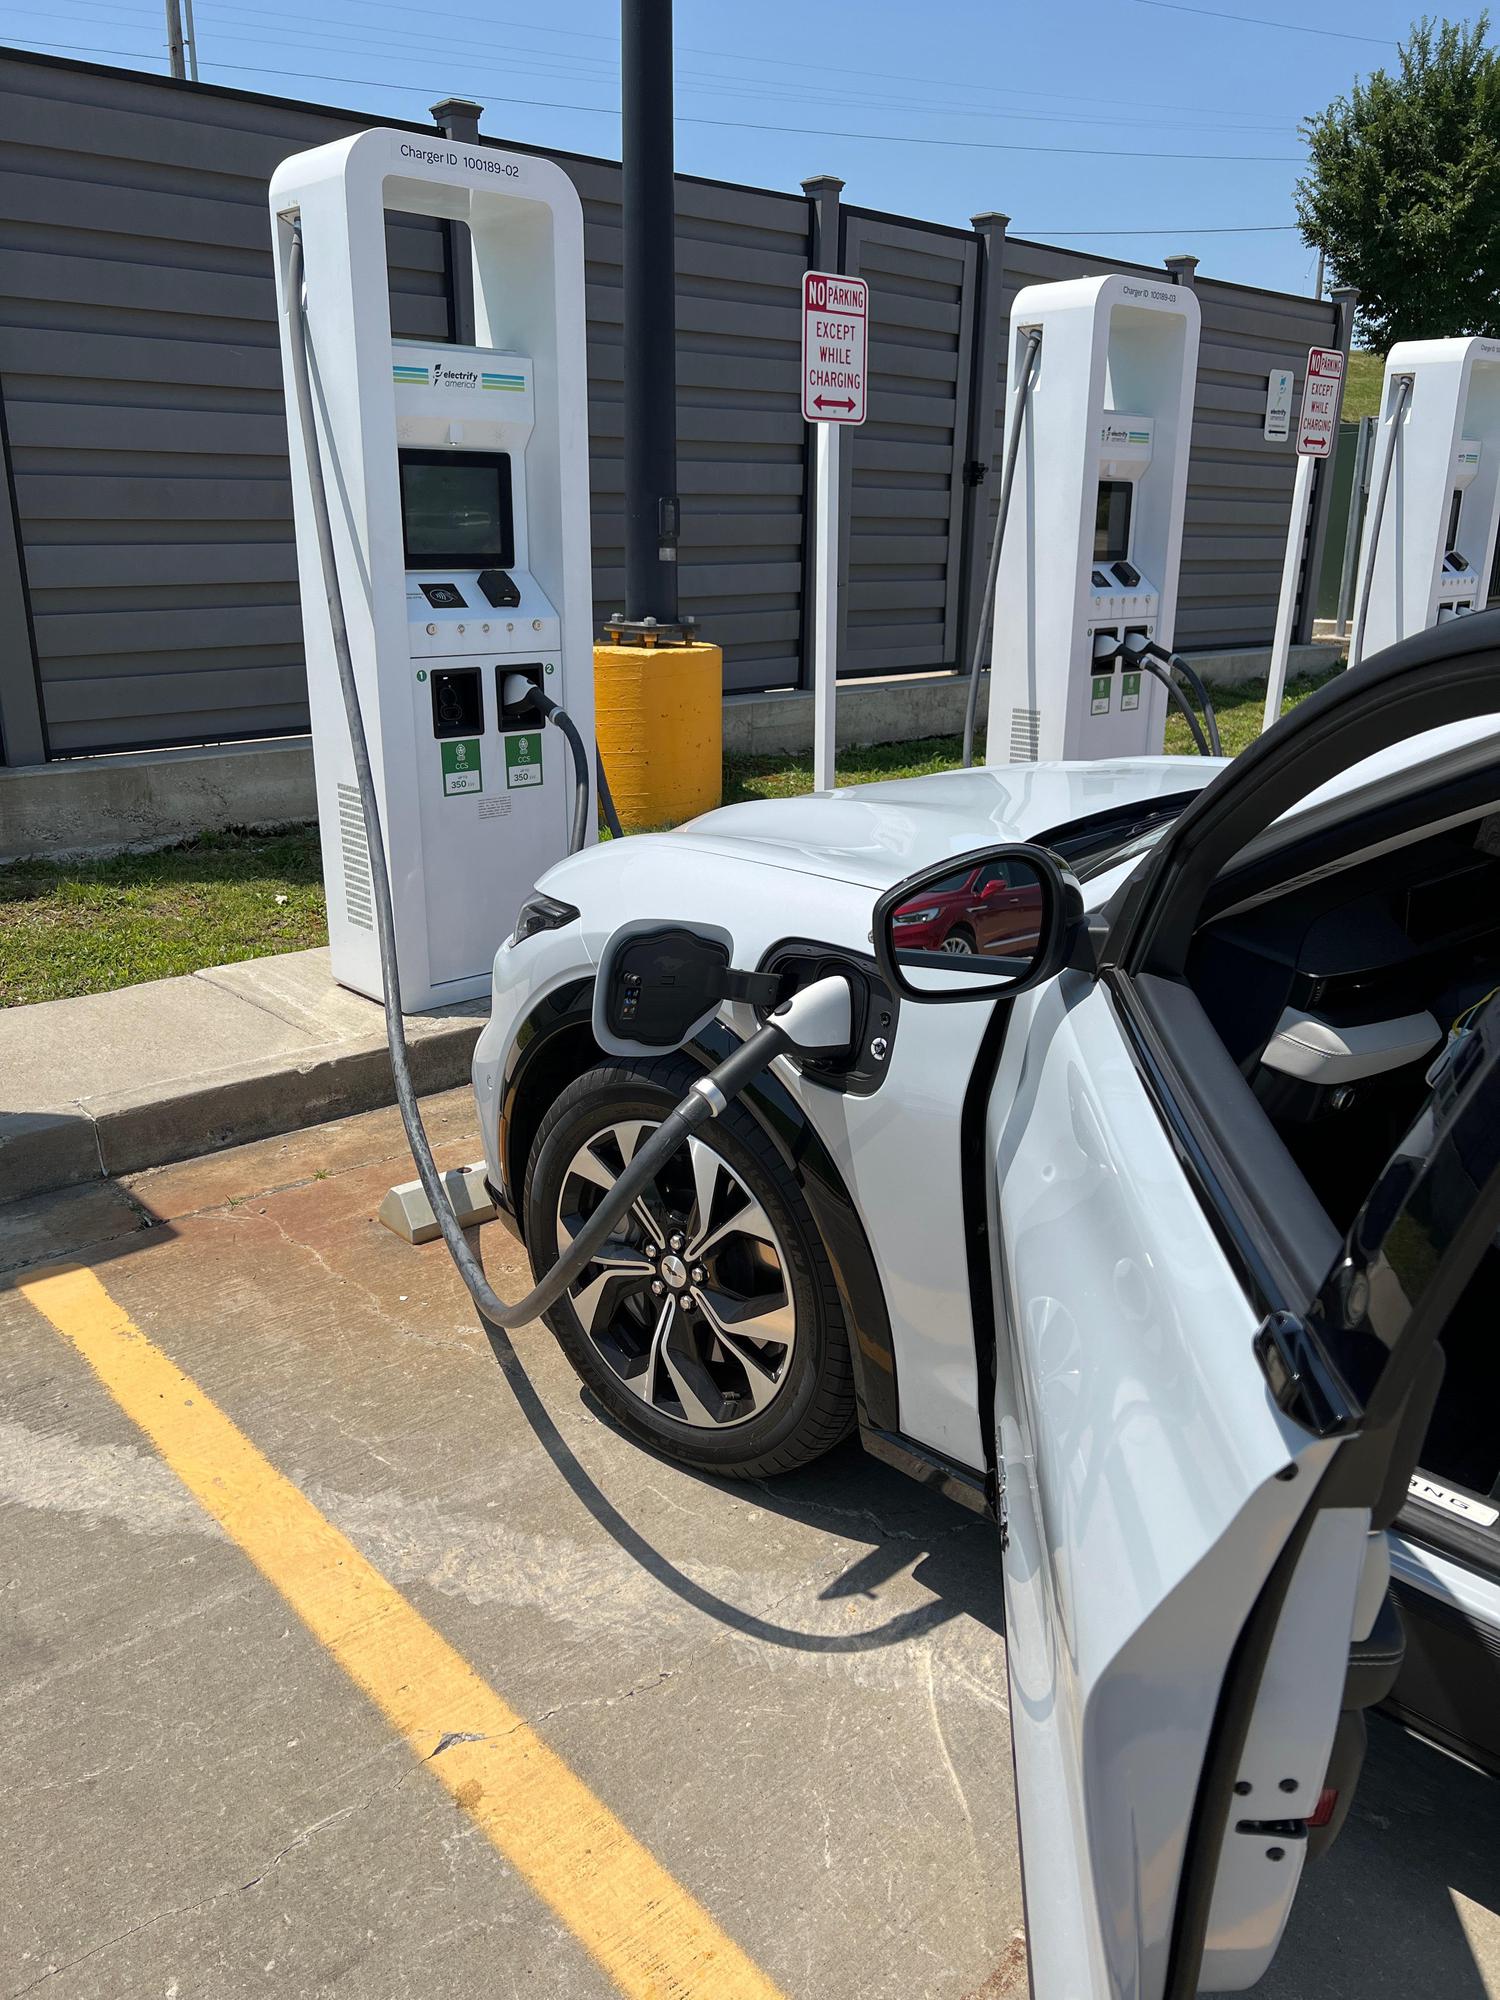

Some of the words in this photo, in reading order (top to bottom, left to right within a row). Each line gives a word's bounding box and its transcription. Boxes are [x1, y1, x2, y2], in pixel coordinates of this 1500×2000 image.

[400, 144, 444, 165] Charger
[446, 153, 458, 166] ID
[463, 157, 520, 178] 100189-02
[808, 280, 826, 306] NO
[827, 286, 864, 309] PARKING
[816, 321, 856, 342] EXCEPT
[819, 346, 852, 365] WHILE
[1310, 354, 1321, 372] NO
[443, 371, 478, 383] electrify
[444, 380, 476, 389] america
[809, 369, 861, 390] CHARGING
[1311, 382, 1334, 397] EXCEPT
[1310, 400, 1329, 415] WHILE
[1303, 417, 1332, 432] CHARGING
[455, 762, 469, 770] CCS
[517, 755, 531, 764] CCS
[451, 780, 467, 789] 350
[514, 773, 529, 782] 350
